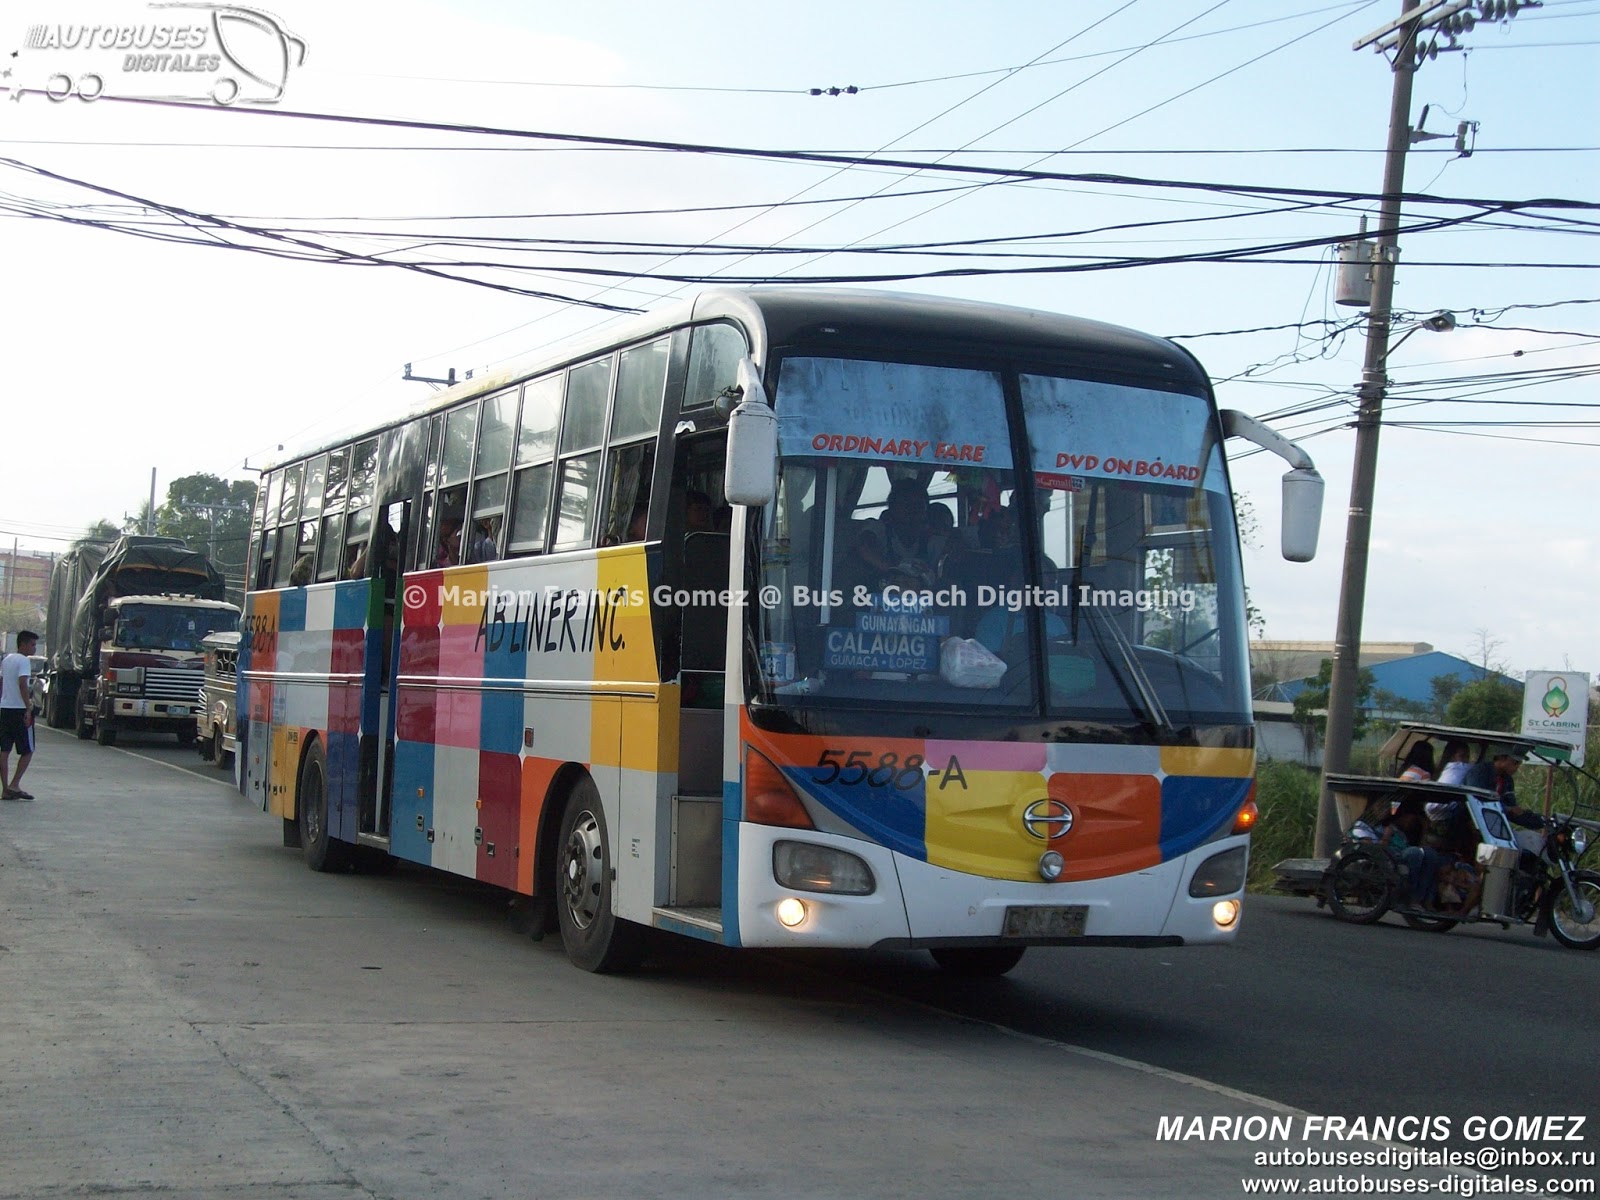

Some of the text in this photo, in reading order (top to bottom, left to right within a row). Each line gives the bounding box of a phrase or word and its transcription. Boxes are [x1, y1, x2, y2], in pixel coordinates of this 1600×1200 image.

[812, 433, 986, 463] ORDINARY FARE
[1056, 453, 1201, 481] DVD ON BOARD
[827, 631, 925, 657] CALAUAG
[831, 656, 927, 670] GUMACA LOPEZ
[1541, 720, 1580, 728] CABRINI
[812, 748, 969, 792] 5588-A
